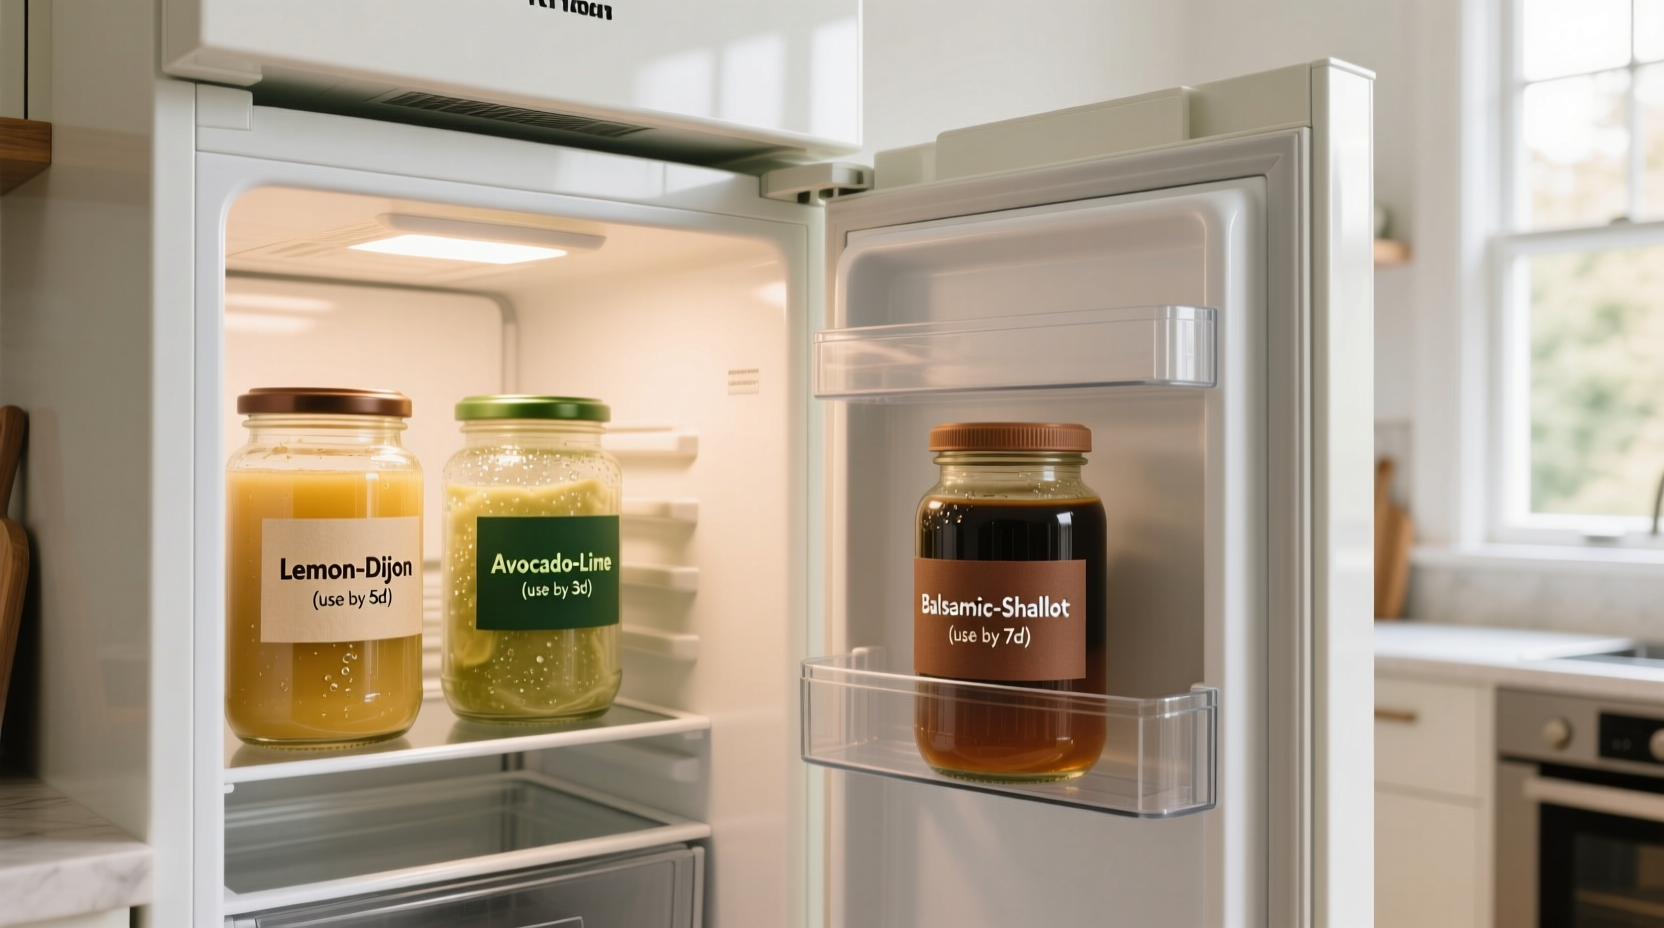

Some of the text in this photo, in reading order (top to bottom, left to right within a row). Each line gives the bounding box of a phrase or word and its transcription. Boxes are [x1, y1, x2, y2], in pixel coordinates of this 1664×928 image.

[280, 555, 412, 584] Lemon-Dijon
[313, 587, 392, 610] (use by 5d)
[522, 578, 593, 601] (use by 3d)
[921, 593, 1071, 618] Balsamic-Shallot
[948, 625, 1031, 648] (use by 7d)
